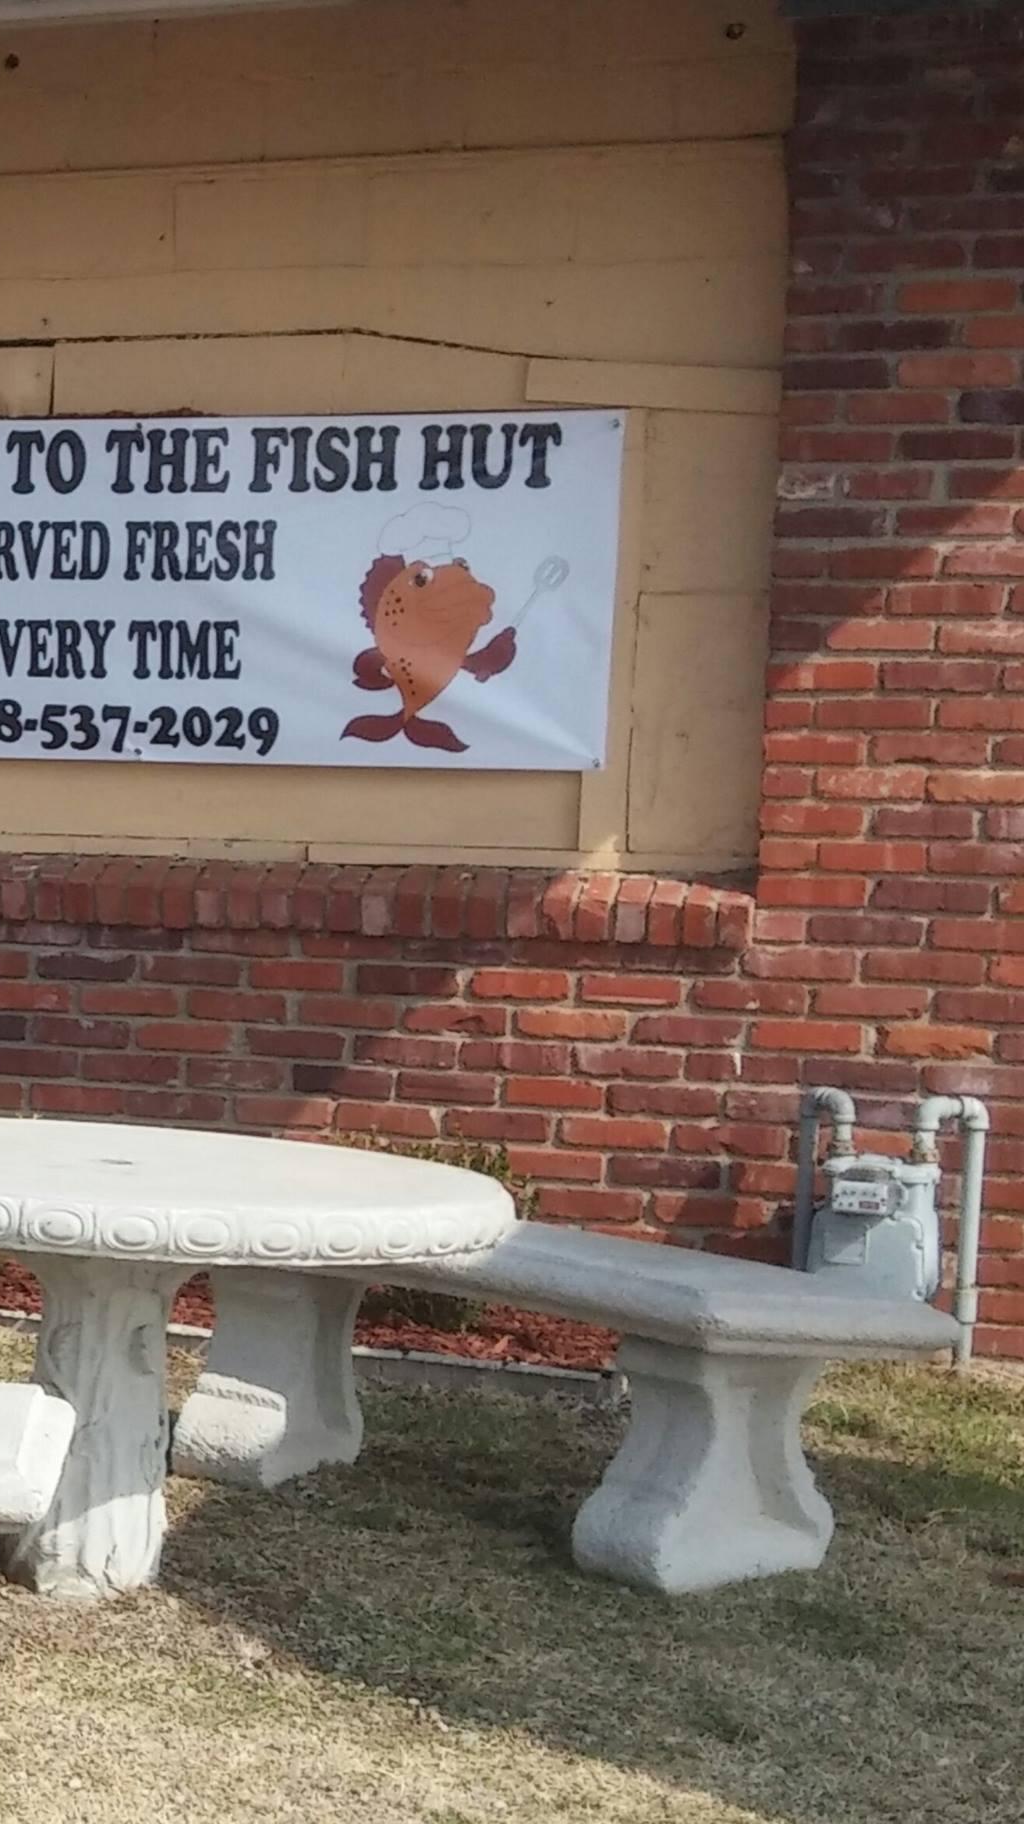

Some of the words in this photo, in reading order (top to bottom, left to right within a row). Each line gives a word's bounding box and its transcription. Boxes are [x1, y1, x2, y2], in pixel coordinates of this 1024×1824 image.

[8, 428, 88, 494] TO
[106, 426, 231, 494] THE
[250, 426, 397, 492] FISH
[418, 422, 562, 490] HUT
[124, 519, 277, 580] FRESH
[128, 620, 242, 680] TIME
